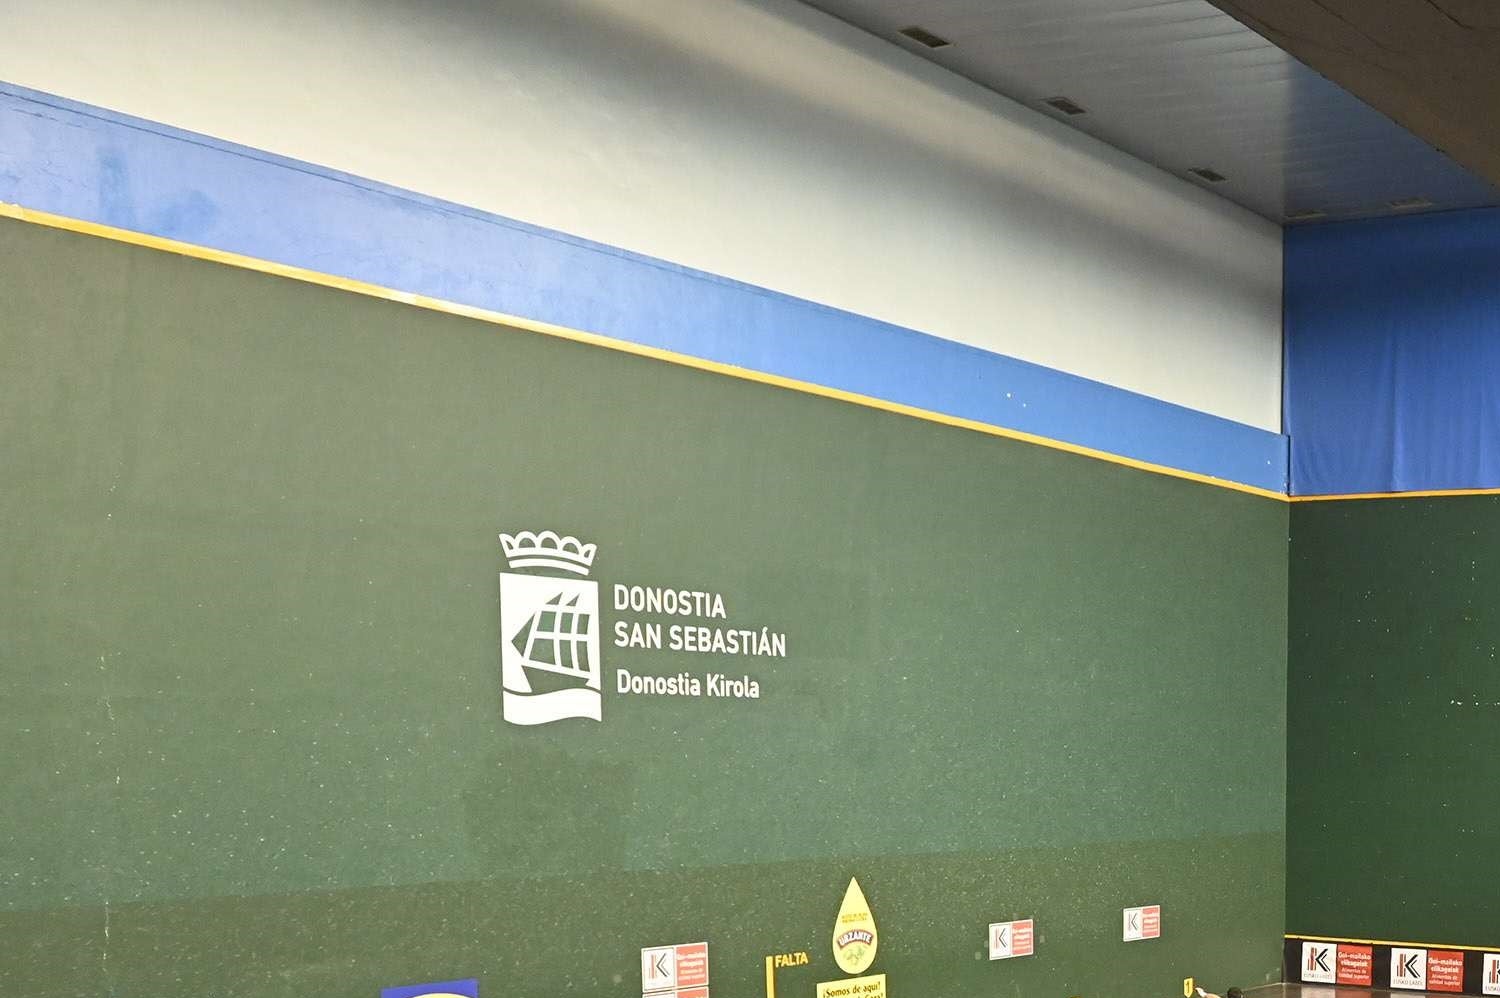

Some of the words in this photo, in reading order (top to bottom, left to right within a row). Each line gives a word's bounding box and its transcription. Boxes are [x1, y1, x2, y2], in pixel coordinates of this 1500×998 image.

[614, 584, 727, 619] DONOSTIA
[614, 621, 662, 649] SAN
[669, 626, 786, 658] SEBASTIÁN
[617, 668, 700, 696] Donostia
[706, 673, 760, 698] Kirola
[838, 930, 873, 947] URZANTE
[775, 952, 809, 968] FALTA
[852, 985, 861, 994] de
